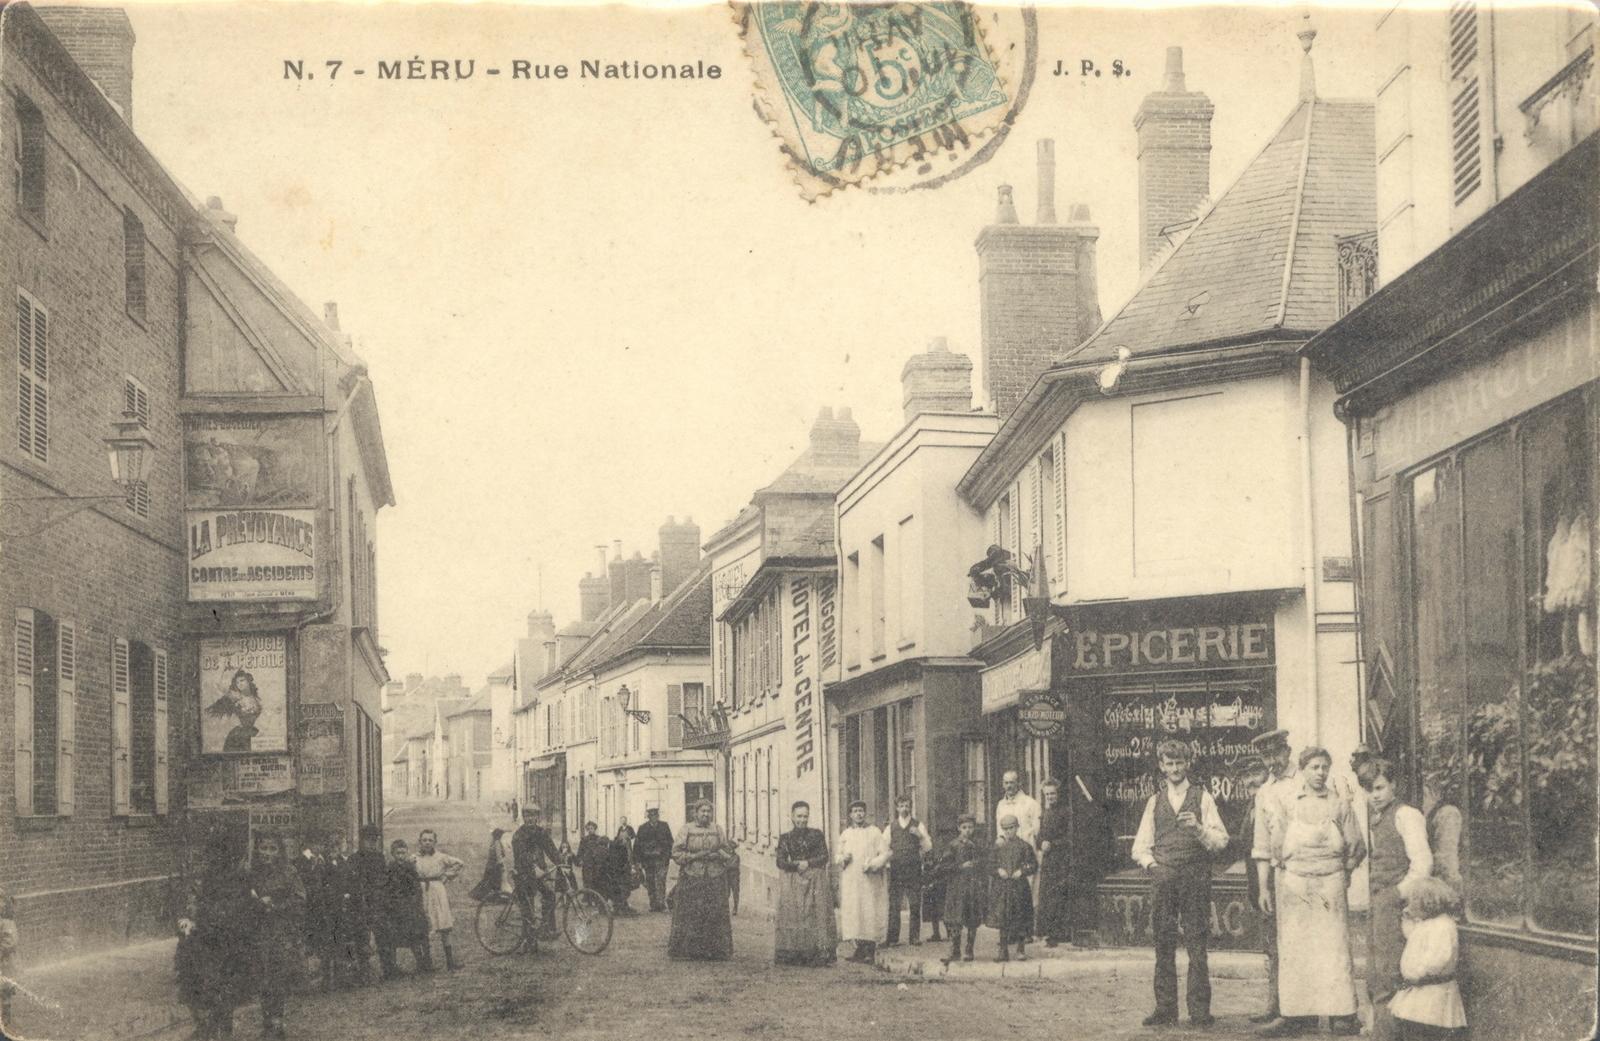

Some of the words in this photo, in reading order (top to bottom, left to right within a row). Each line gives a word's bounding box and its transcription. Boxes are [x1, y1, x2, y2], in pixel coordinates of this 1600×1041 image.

[861, 101, 956, 155] POSTES
[191, 520, 212, 561] LA
[191, 566, 238, 582] CONTRE
[248, 565, 314, 582] ACCIDENTS
[791, 576, 811, 656] HOTEL
[240, 636, 284, 655] BOUGIE
[793, 654, 811, 677] du
[1025, 694, 1060, 707] ESSENCE
[794, 676, 815, 779] CENTRE
